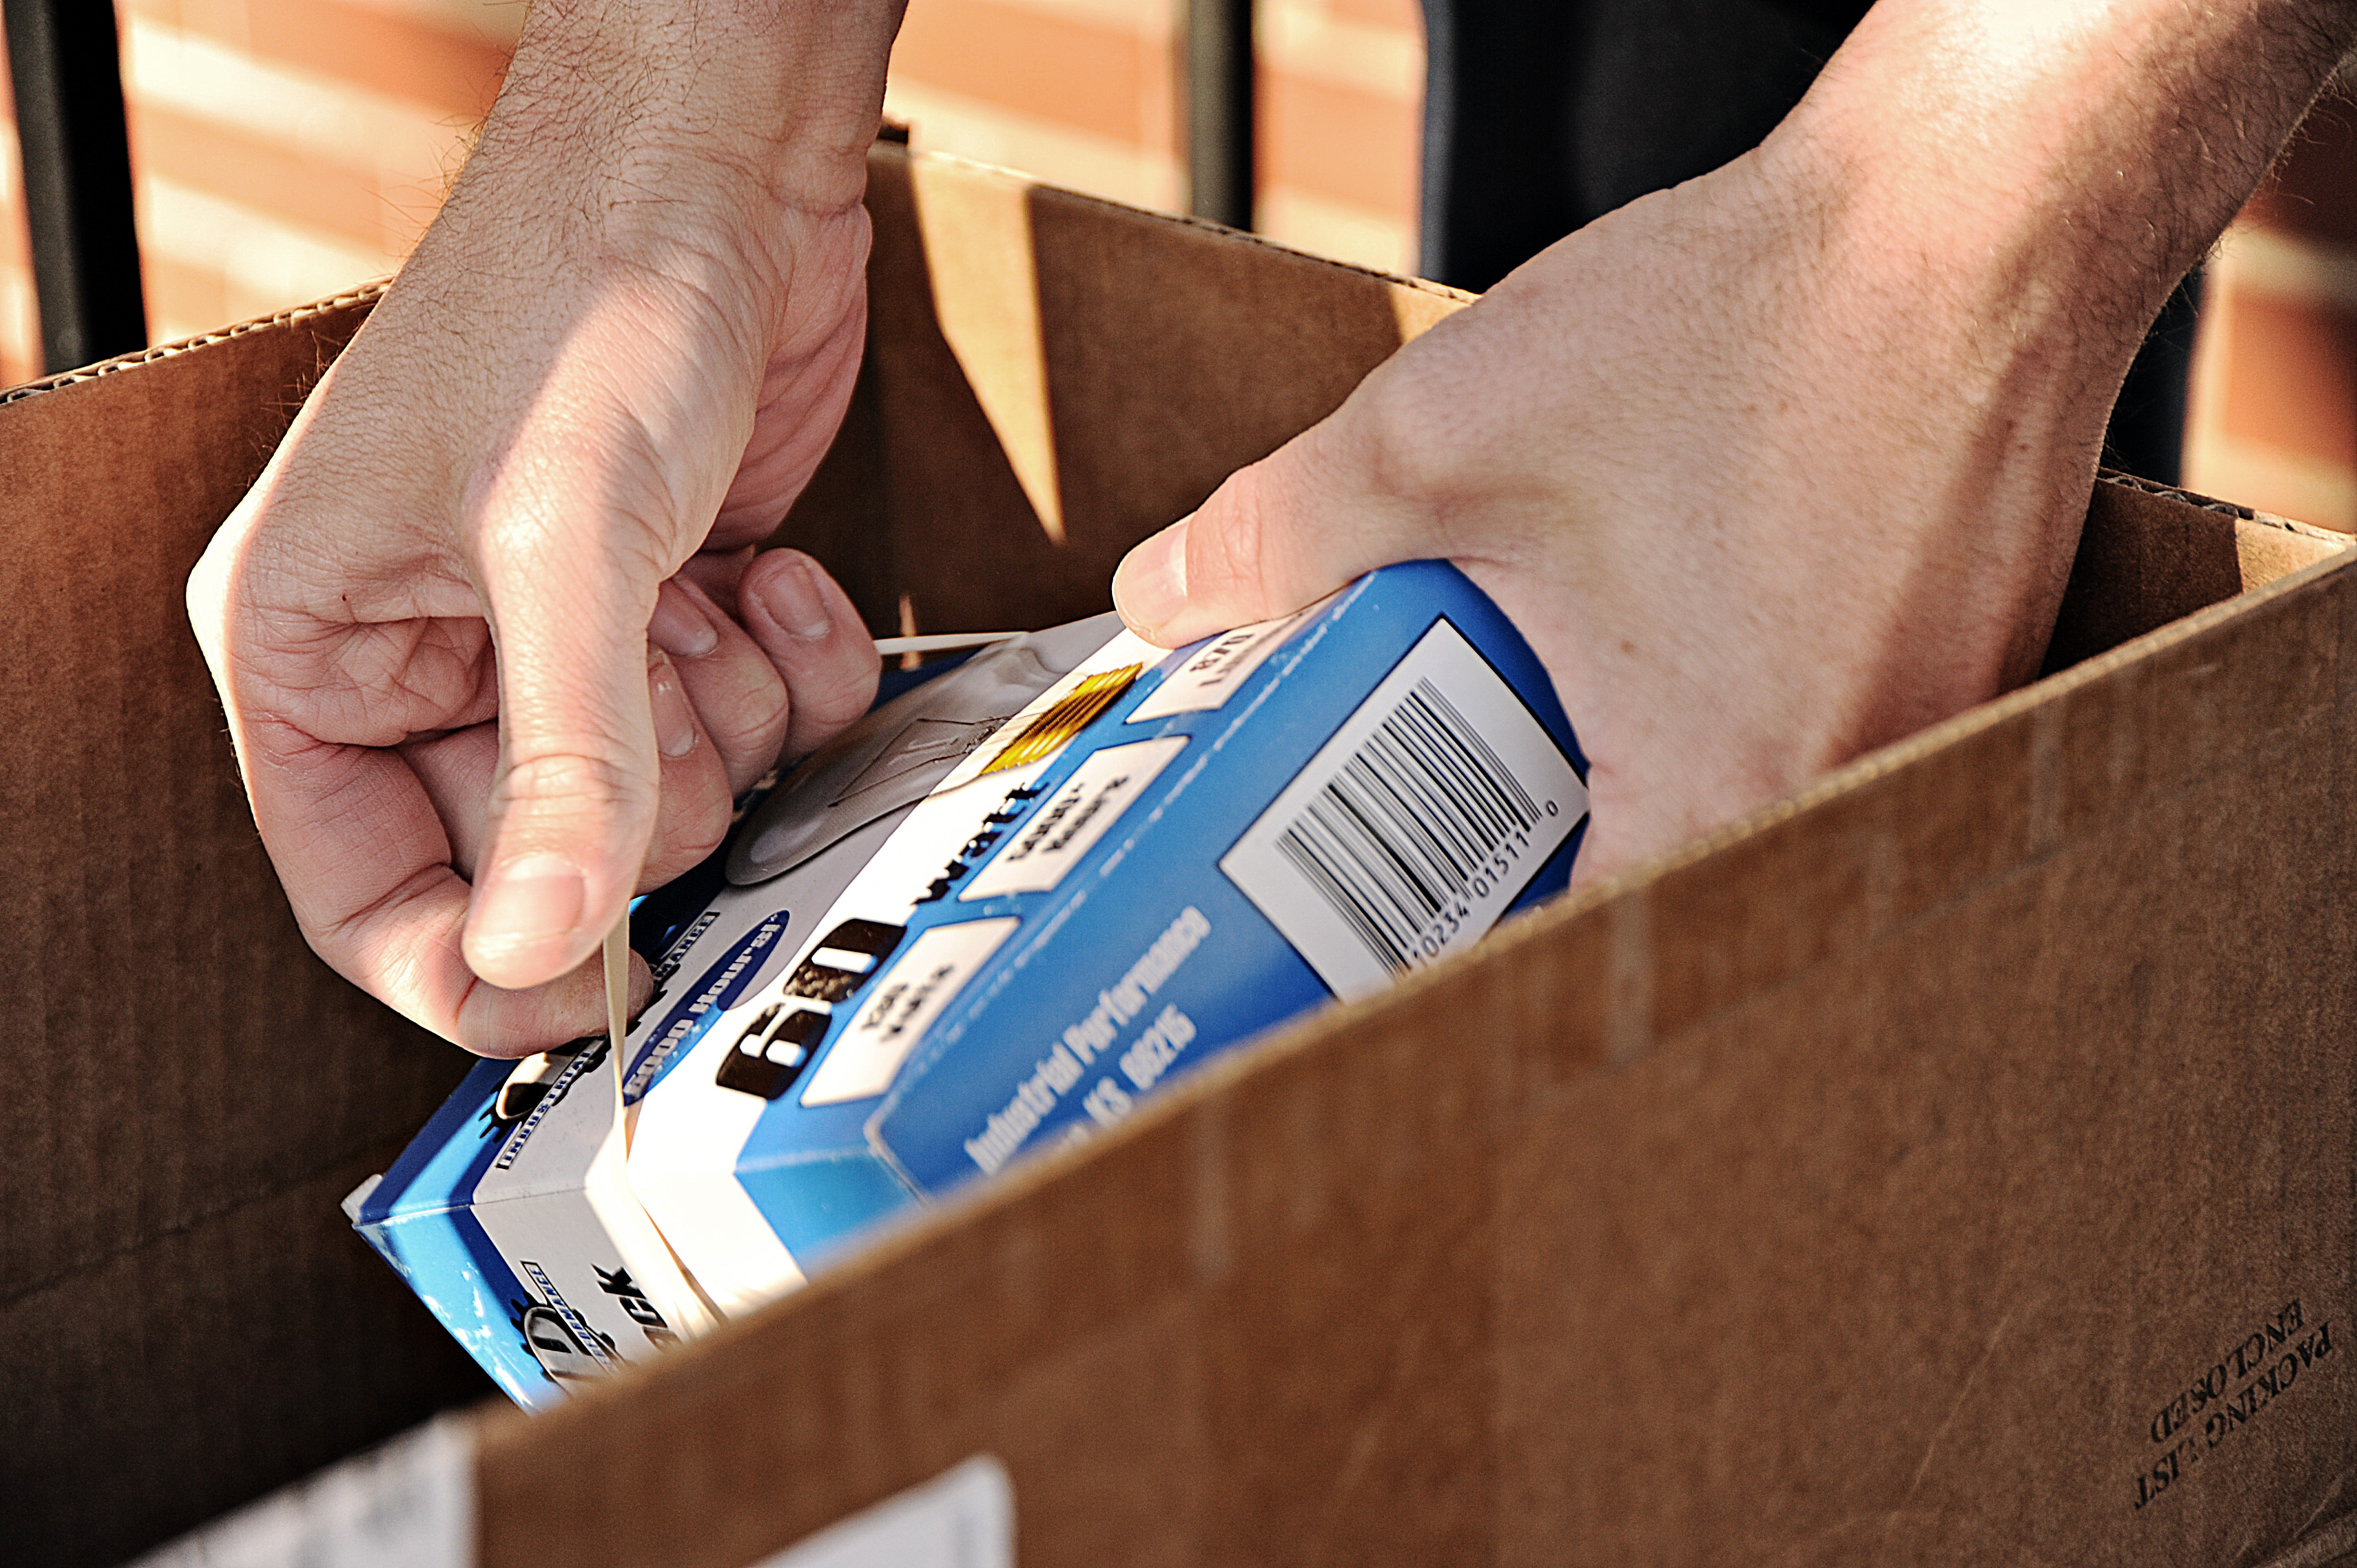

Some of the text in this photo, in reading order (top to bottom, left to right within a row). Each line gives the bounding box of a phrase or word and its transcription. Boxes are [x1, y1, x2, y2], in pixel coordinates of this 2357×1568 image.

[1189, 633, 1254, 672] 870
[1473, 831, 1530, 898] 01511
[716, 917, 908, 1101] 60
[912, 782, 1050, 905] watt
[963, 1041, 1084, 1175] Industrial
[1063, 905, 1212, 1065] Performance
[503, 1050, 594, 1162] INDUSTRIAL
[2150, 1298, 2305, 1444] ENCLOSED
[2204, 1322, 2333, 1450] PACKING
